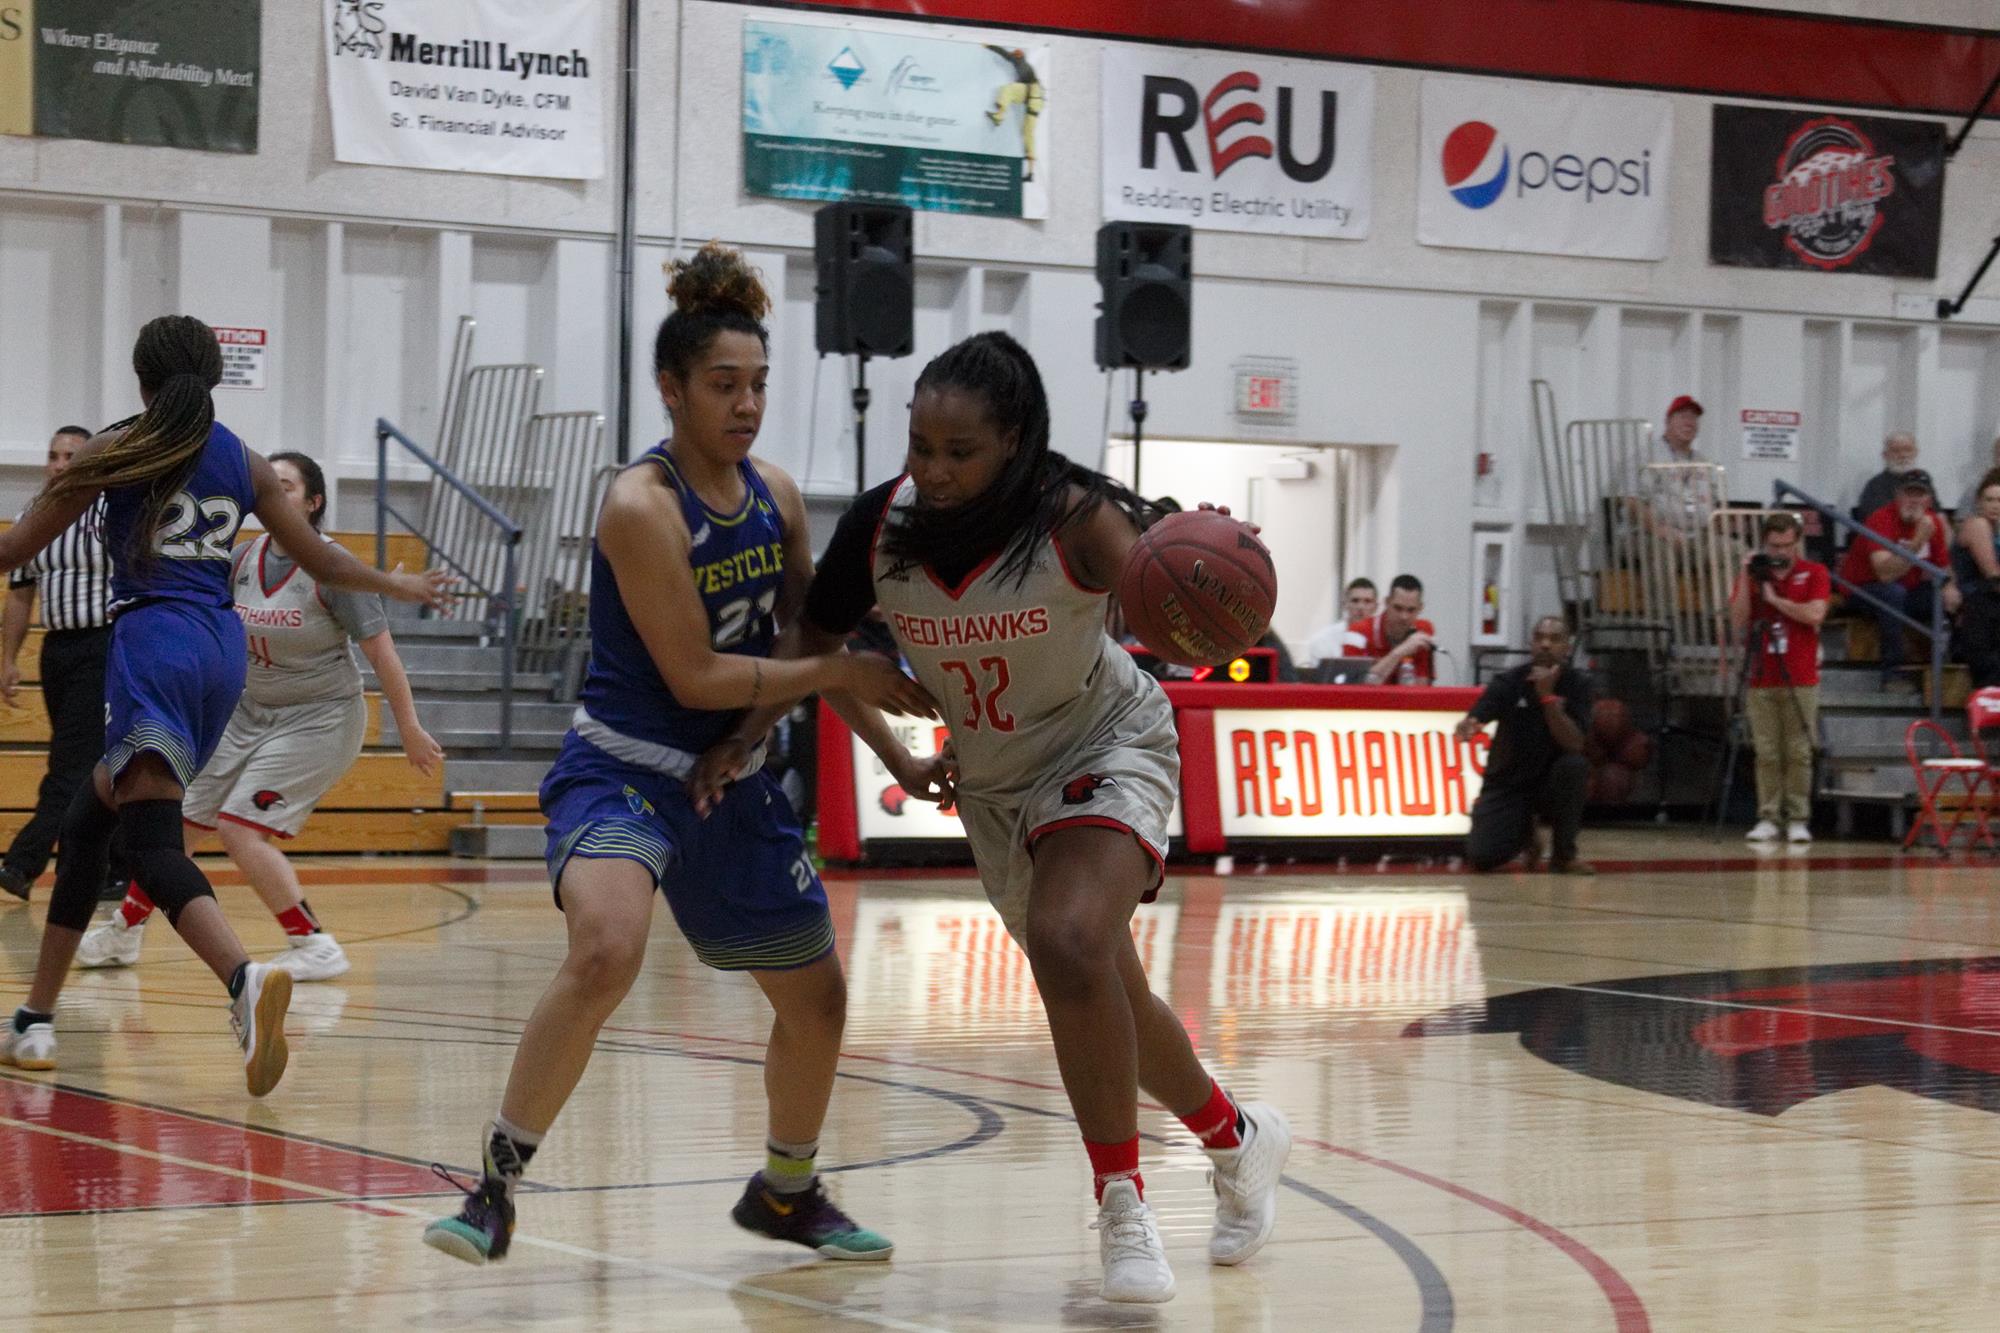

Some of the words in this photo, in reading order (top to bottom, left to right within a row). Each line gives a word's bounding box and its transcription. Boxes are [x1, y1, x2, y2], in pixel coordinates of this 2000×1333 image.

[41, 27, 91, 49] Where
[94, 33, 160, 55] Elegance
[389, 33, 491, 70] Merrill
[499, 42, 589, 80] Lynch
[93, 57, 124, 76] and
[126, 60, 213, 87] Affordability
[214, 68, 254, 87] Meet
[390, 80, 439, 100] David
[444, 85, 477, 103] Van
[533, 92, 571, 111] CFM
[390, 112, 413, 129] Sr.
[418, 114, 496, 136] Financial
[501, 122, 566, 142] Advisor
[1140, 71, 1338, 183] REU
[1517, 150, 1650, 203] pepsi
[1122, 185, 1203, 217] Redding
[1209, 192, 1284, 217] Electric
[1292, 198, 1351, 227] Utility
[893, 611, 939, 647] RED
[941, 606, 1049, 647] HAWKS
[938, 655, 1016, 732] 32
[1231, 729, 1322, 817] RED
